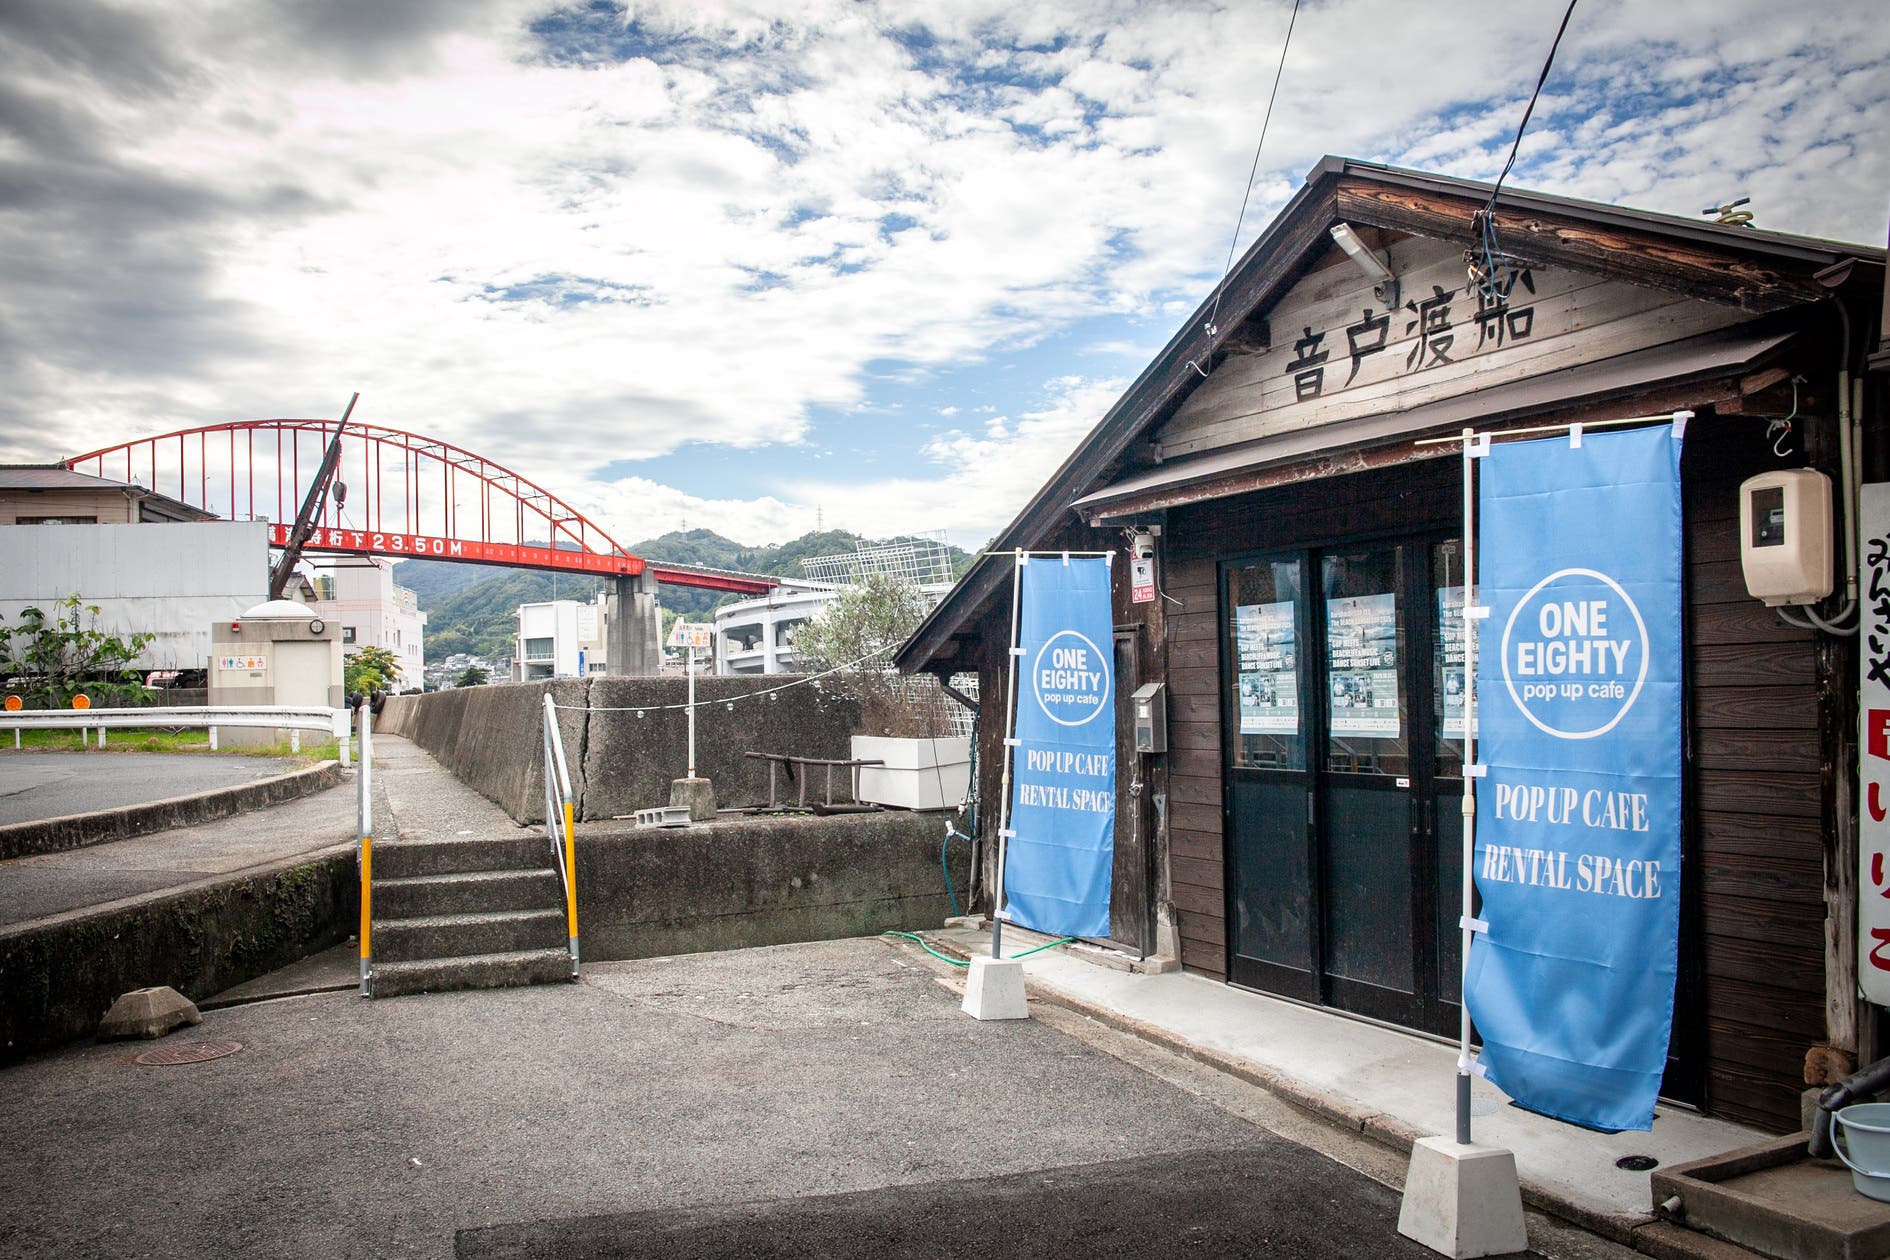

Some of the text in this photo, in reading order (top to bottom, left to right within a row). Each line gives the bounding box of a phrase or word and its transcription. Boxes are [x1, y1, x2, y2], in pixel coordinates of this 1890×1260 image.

[1539, 600, 1608, 639] ONE
[1052, 648, 1087, 670] ONE
[1517, 639, 1631, 676] EIGHTY
[1041, 670, 1102, 692] EIGHTY
[1523, 679, 1625, 702] pop up cafe
[1044, 694, 1099, 705] pop up cafe
[1027, 748, 1109, 776] POP UP CAFE
[1019, 783, 1111, 814] RENTAL SPACE
[1495, 783, 1650, 833] POP UP CAFE
[1482, 843, 1662, 900] RENTAL SPACE
